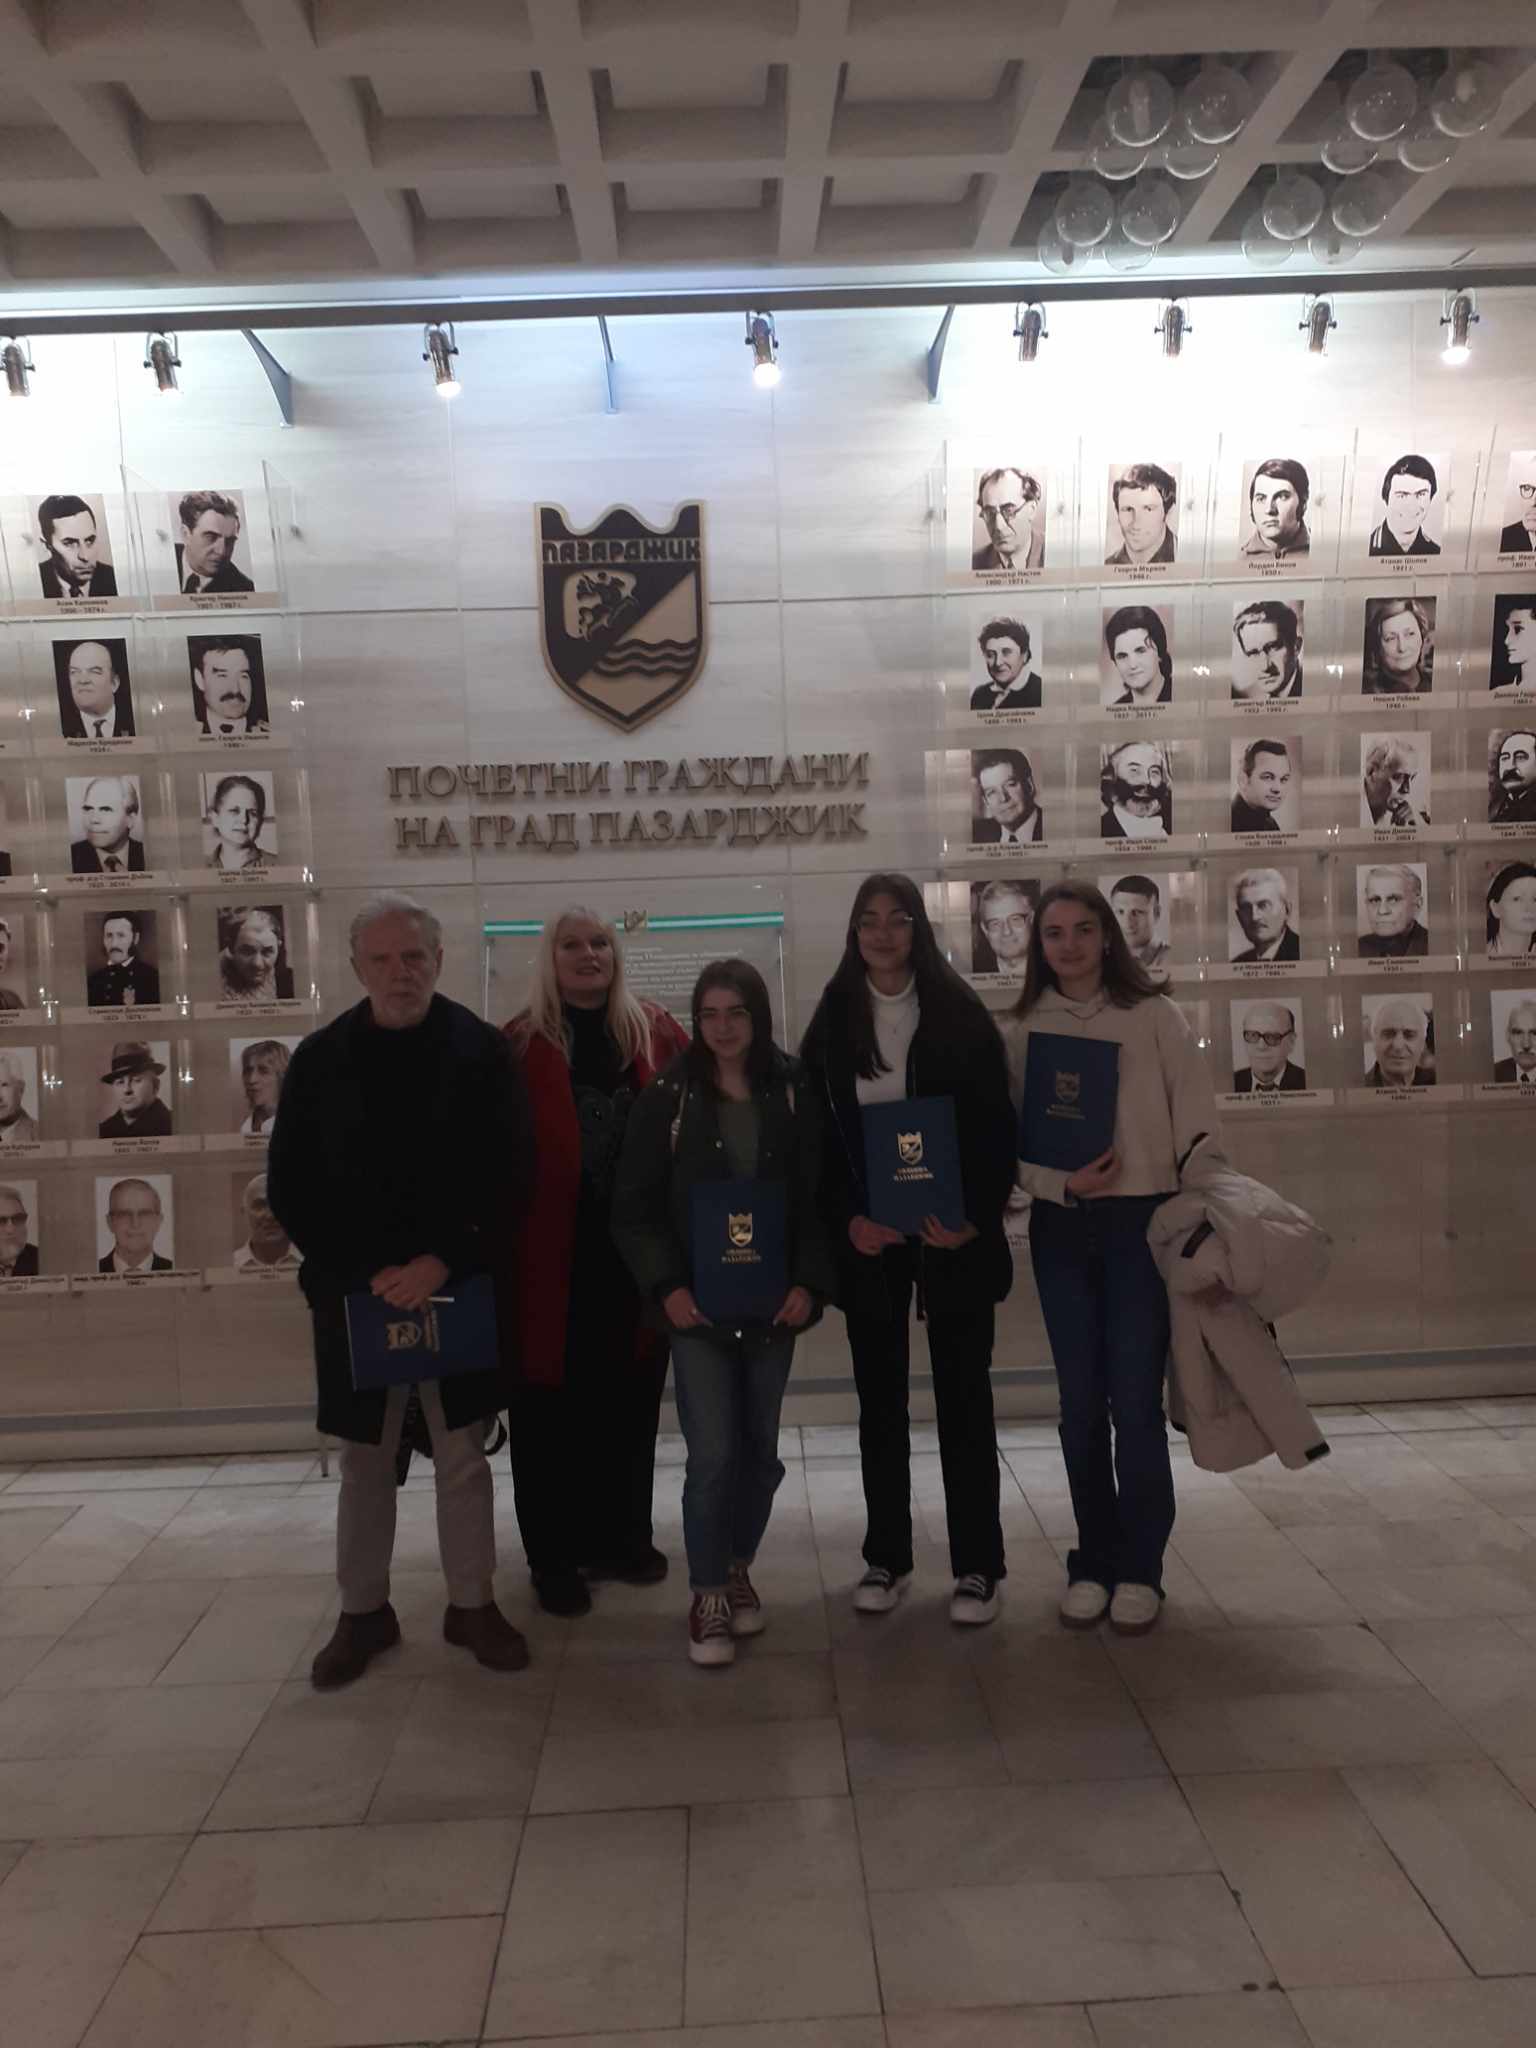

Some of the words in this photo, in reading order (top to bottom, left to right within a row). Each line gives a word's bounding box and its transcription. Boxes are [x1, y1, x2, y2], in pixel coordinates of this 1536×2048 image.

[541, 538, 701, 563] ПАЗАРДЖИК
[387, 761, 611, 799] ПОЧЕТНИ
[623, 752, 870, 795] ГРАЖДАНИ
[394, 815, 460, 850] НА
[470, 813, 580, 852] ГРАД
[589, 803, 868, 848] ПАЗАРДЖИК
